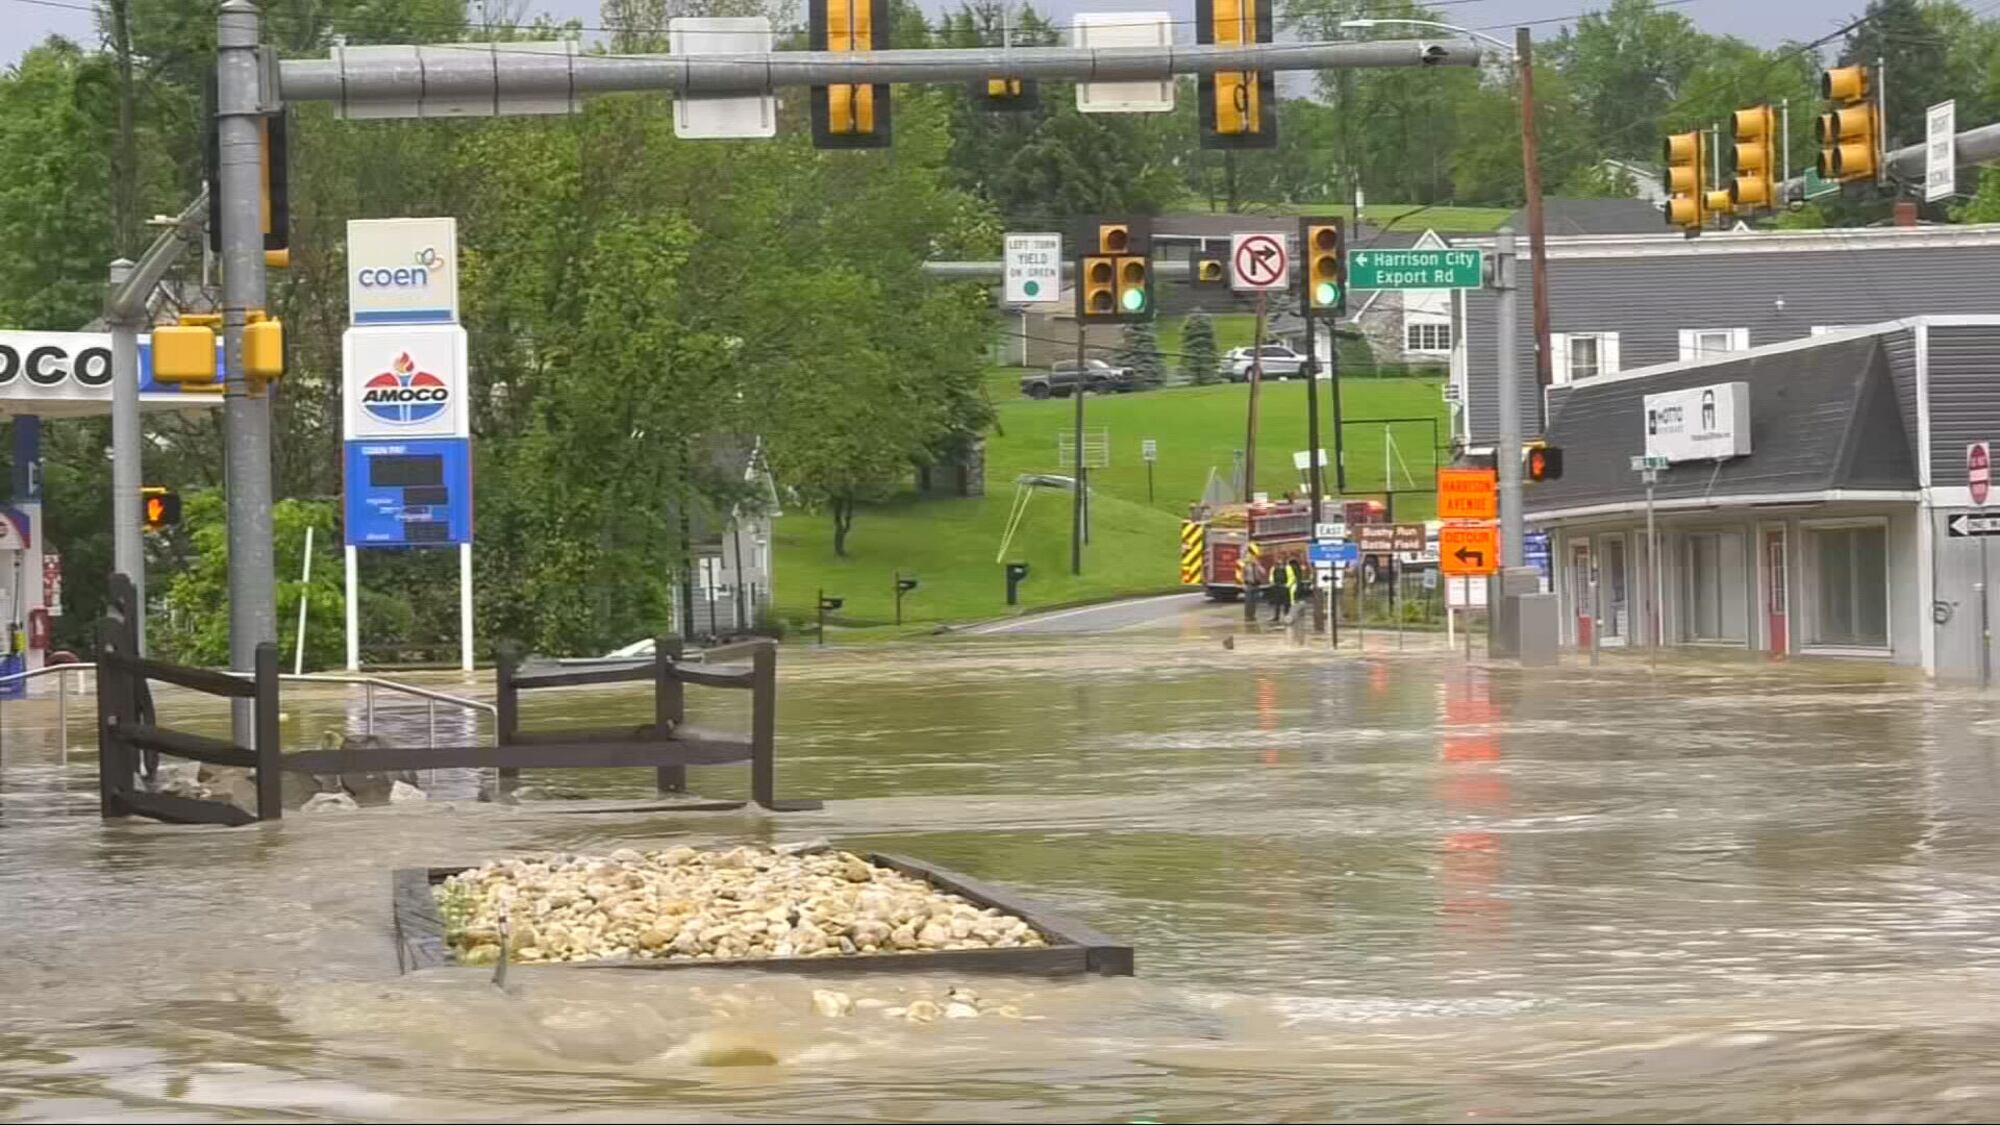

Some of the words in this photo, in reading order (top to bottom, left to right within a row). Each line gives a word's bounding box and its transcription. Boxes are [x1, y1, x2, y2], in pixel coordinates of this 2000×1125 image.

[1008, 240, 1028, 250] LEFT
[1018, 252, 1048, 265] YIELD
[1374, 252, 1439, 267] Harrison
[1445, 252, 1475, 268] City
[358, 267, 428, 288] coen
[1009, 267, 1022, 278] ON
[1028, 267, 1056, 278] GREEN
[1376, 269, 1428, 286] Export
[1433, 269, 1455, 283] Rd
[362, 387, 449, 403] AMOCO
[1447, 497, 1487, 510] AVENUE
[1319, 525, 1342, 536] EAST
[1396, 525, 1418, 536] Run
[1445, 531, 1489, 543] DETOUR
[1360, 539, 1392, 550] Battle
[1394, 538, 1420, 549] Field
